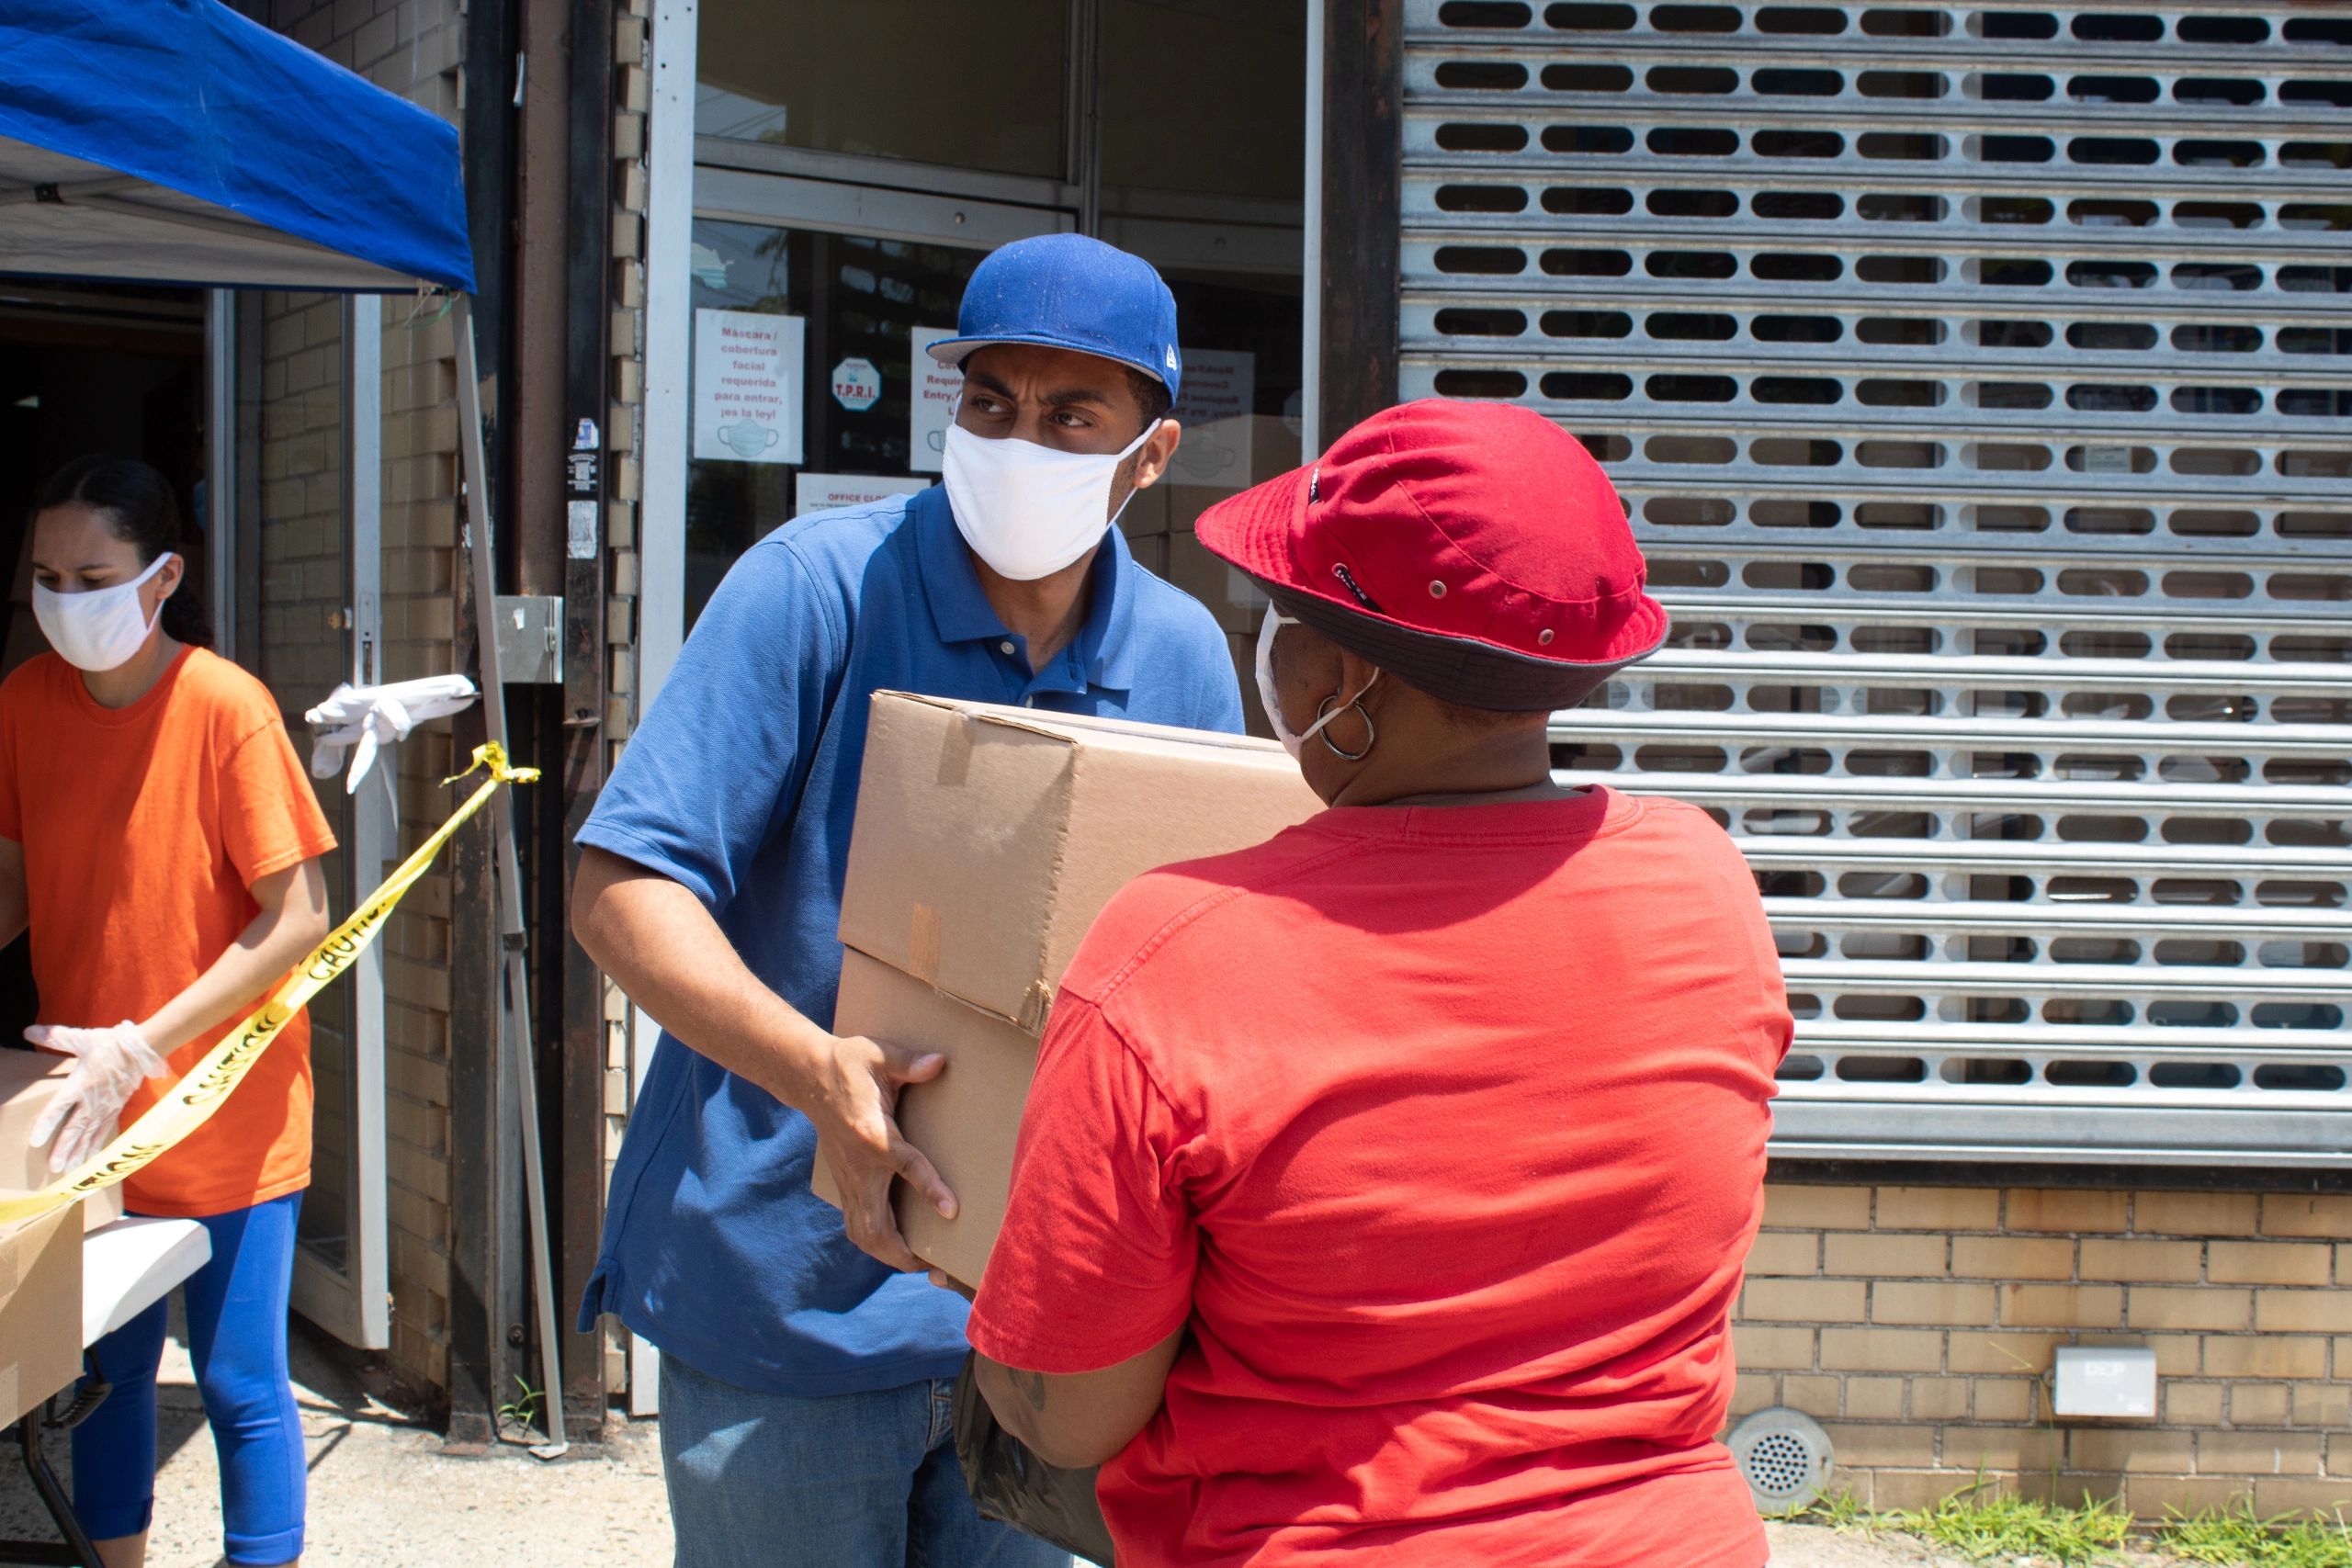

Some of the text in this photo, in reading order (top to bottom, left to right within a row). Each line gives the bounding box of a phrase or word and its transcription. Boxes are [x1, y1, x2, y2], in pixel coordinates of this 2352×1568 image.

[720, 345, 777, 356] cobertura
[732, 359, 764, 371] facial
[721, 377, 775, 388] requerida
[926, 375, 964, 386] Requir
[836, 384, 876, 399] T.P.R.I.
[714, 392, 783, 406] para entrar,
[741, 407, 752, 417] la
[755, 409, 776, 421] ley!
[828, 492, 862, 502] OFFICE
